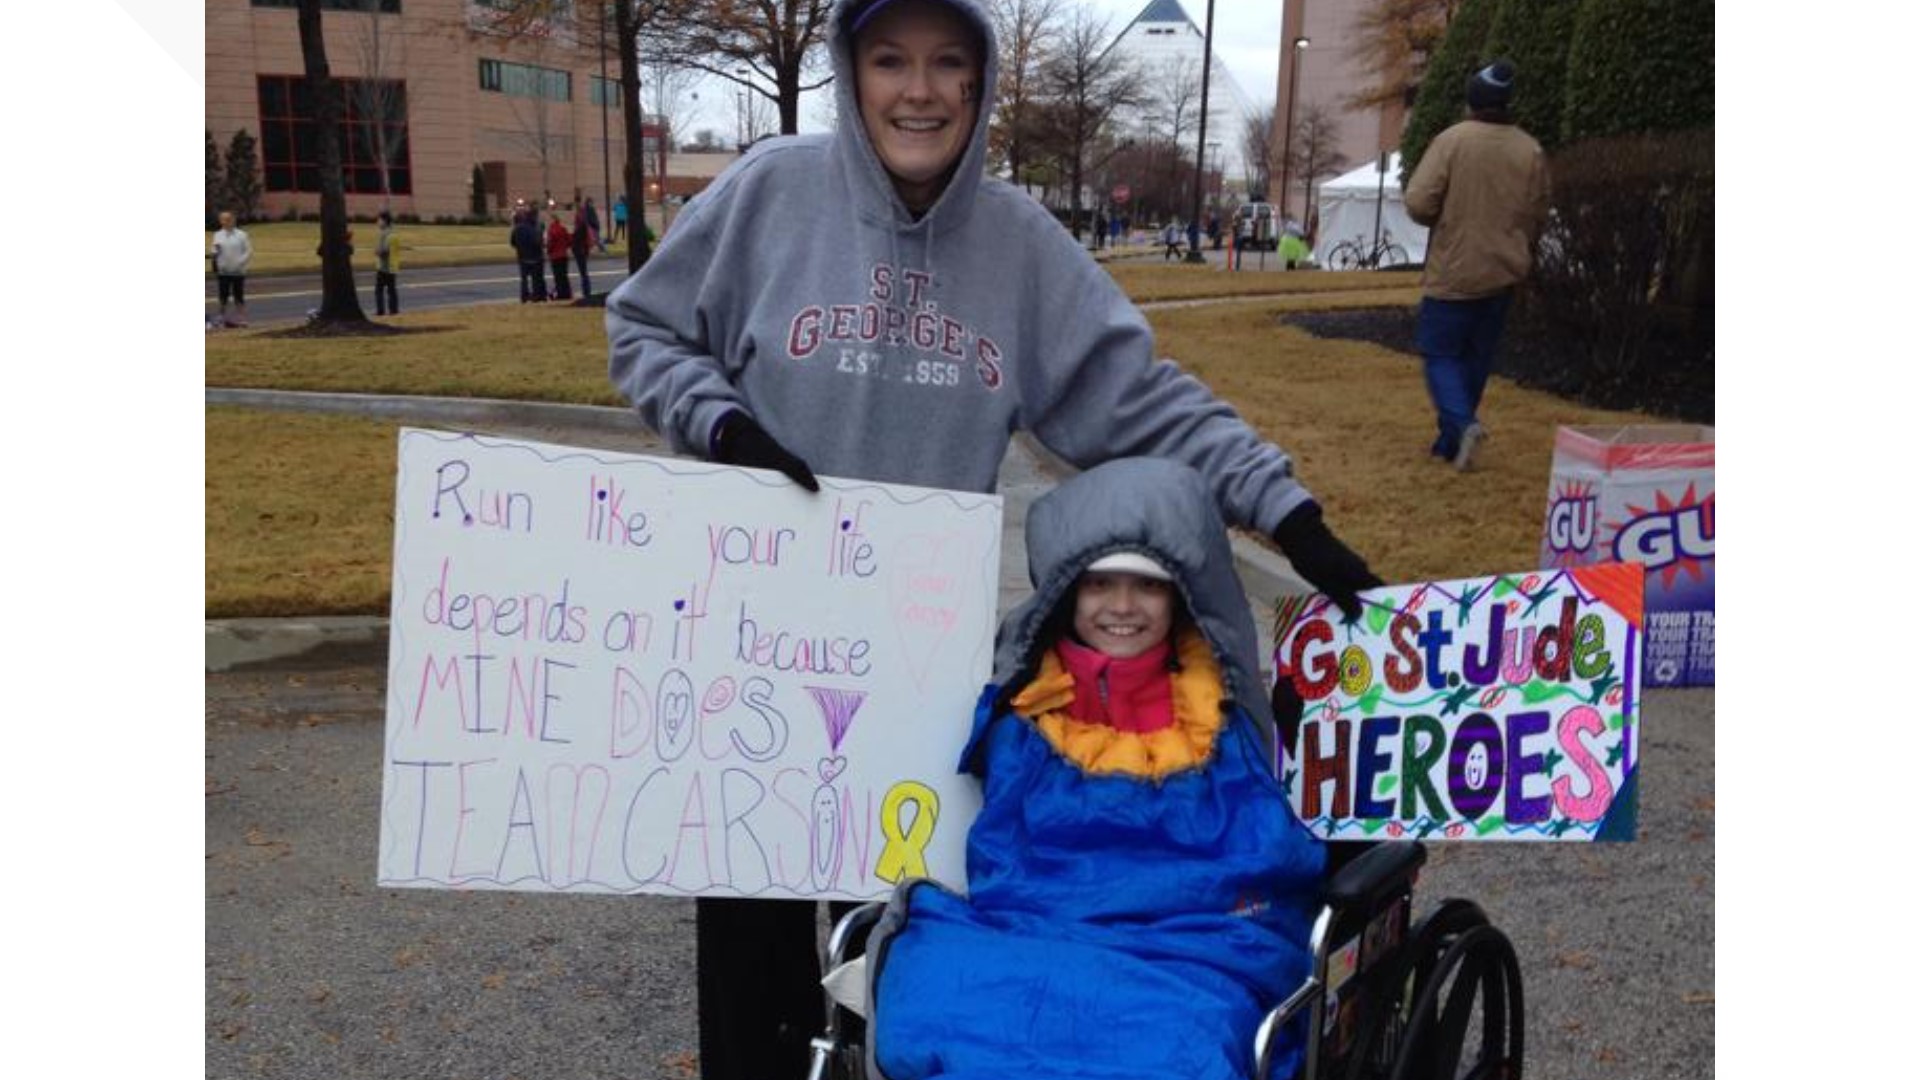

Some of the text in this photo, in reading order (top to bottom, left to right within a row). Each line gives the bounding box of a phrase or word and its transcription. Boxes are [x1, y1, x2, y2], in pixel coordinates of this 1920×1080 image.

[787, 302, 1004, 391] GEORGE'S
[432, 459, 878, 616] Run like your life
[1550, 495, 1597, 553] GU
[422, 555, 873, 677] depends on it because
[1291, 596, 1612, 700] Go St. Jude
[1649, 610, 1715, 627] YOUR TR
[413, 653, 577, 744] MINE
[1302, 705, 1614, 824] HEROES
[392, 757, 872, 892] TEAM CARSON
